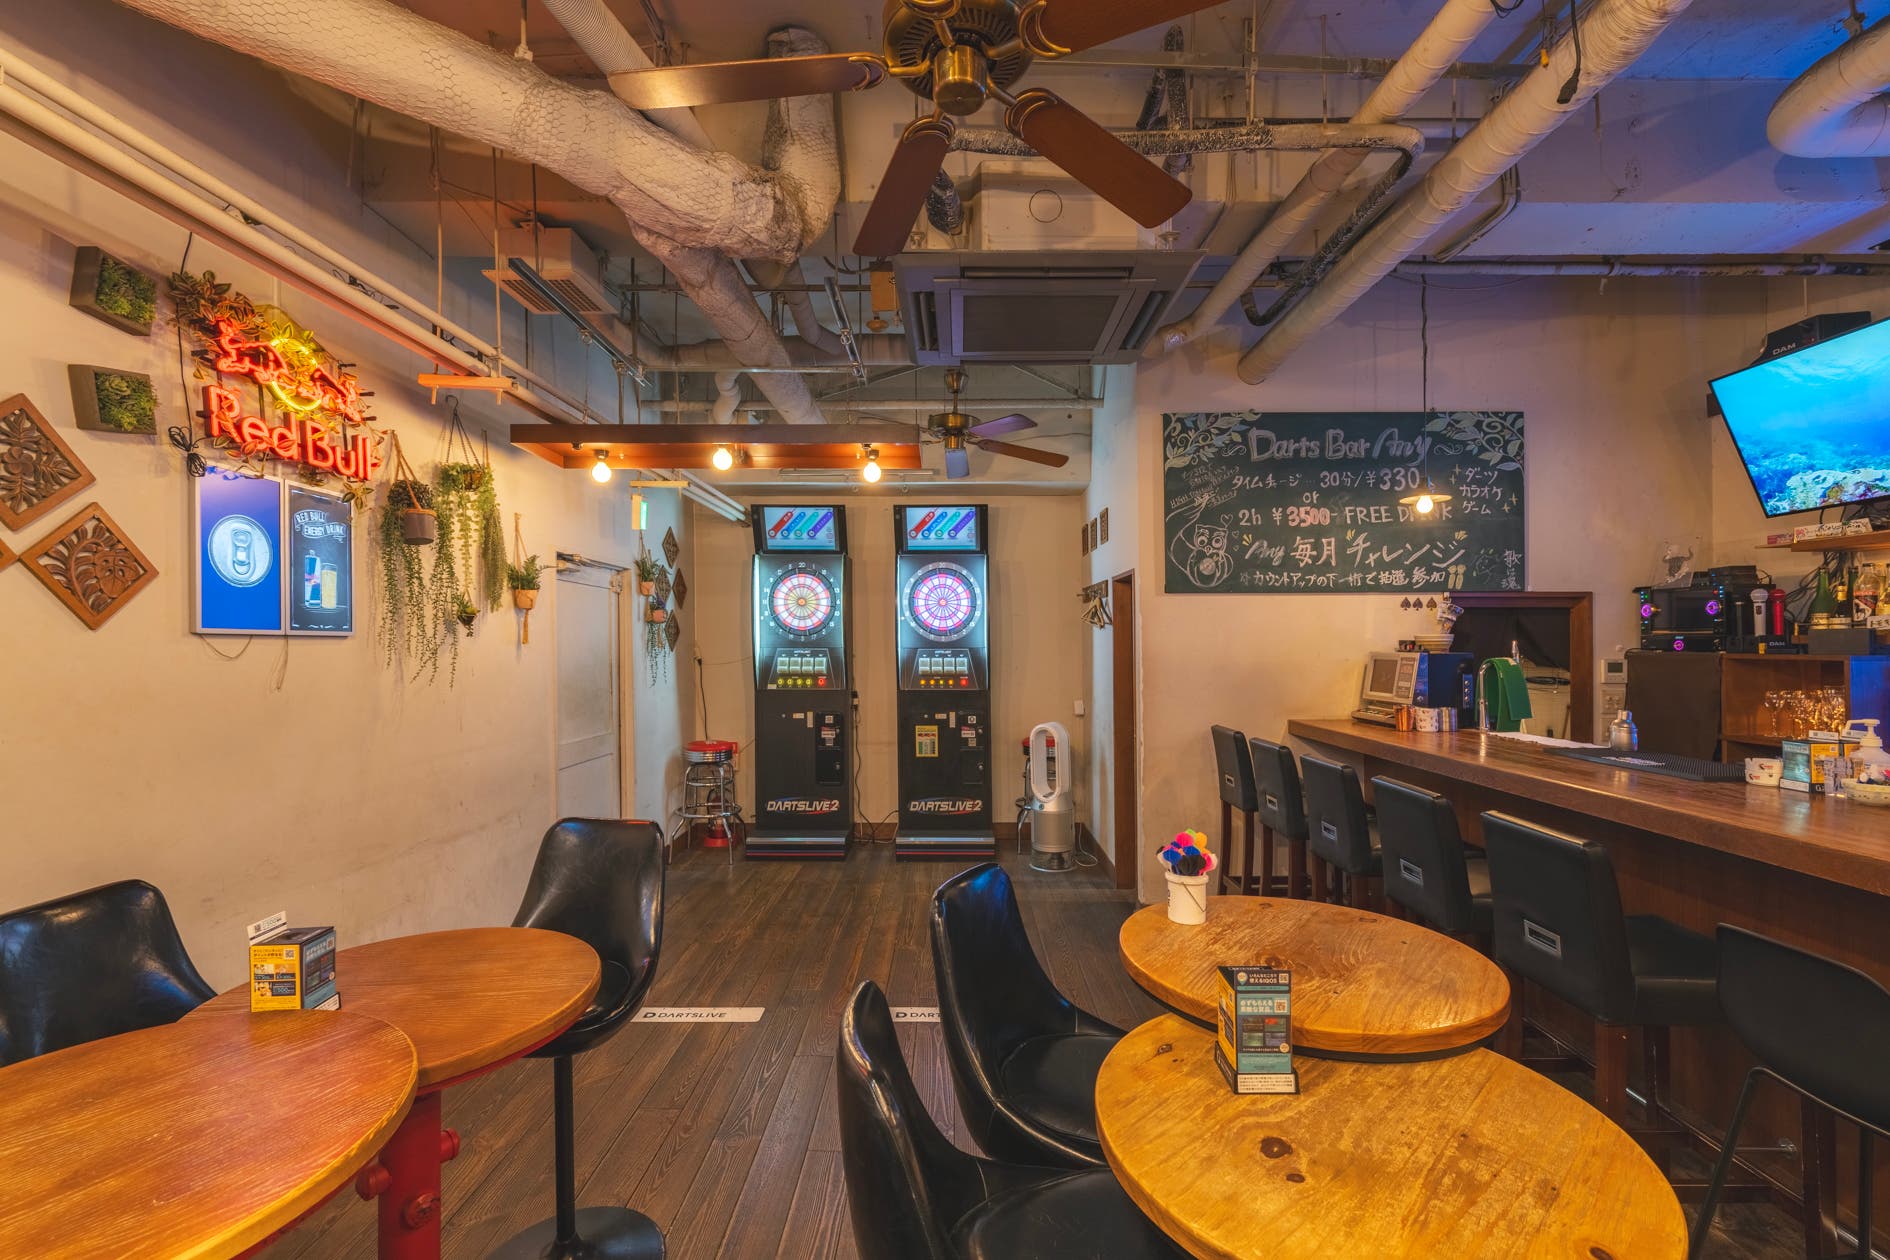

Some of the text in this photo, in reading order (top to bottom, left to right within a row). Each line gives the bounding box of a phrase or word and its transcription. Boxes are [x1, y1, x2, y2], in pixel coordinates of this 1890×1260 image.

[1772, 342, 1796, 355] DAM
[208, 384, 372, 481] Red Bull
[1249, 427, 1433, 466] Darts Bar Any
[1465, 467, 1498, 485] ダーツ
[1302, 491, 1319, 503] or
[1459, 485, 1503, 501] カラオケ
[1238, 508, 1262, 526] 2h
[1344, 505, 1393, 524] FREE
[1462, 501, 1492, 515] ゲーム
[1244, 532, 1466, 568] Any 毎月 チャレンジ
[766, 799, 840, 811] DARTSLIVE2
[909, 799, 982, 811] DARTSLIVE2
